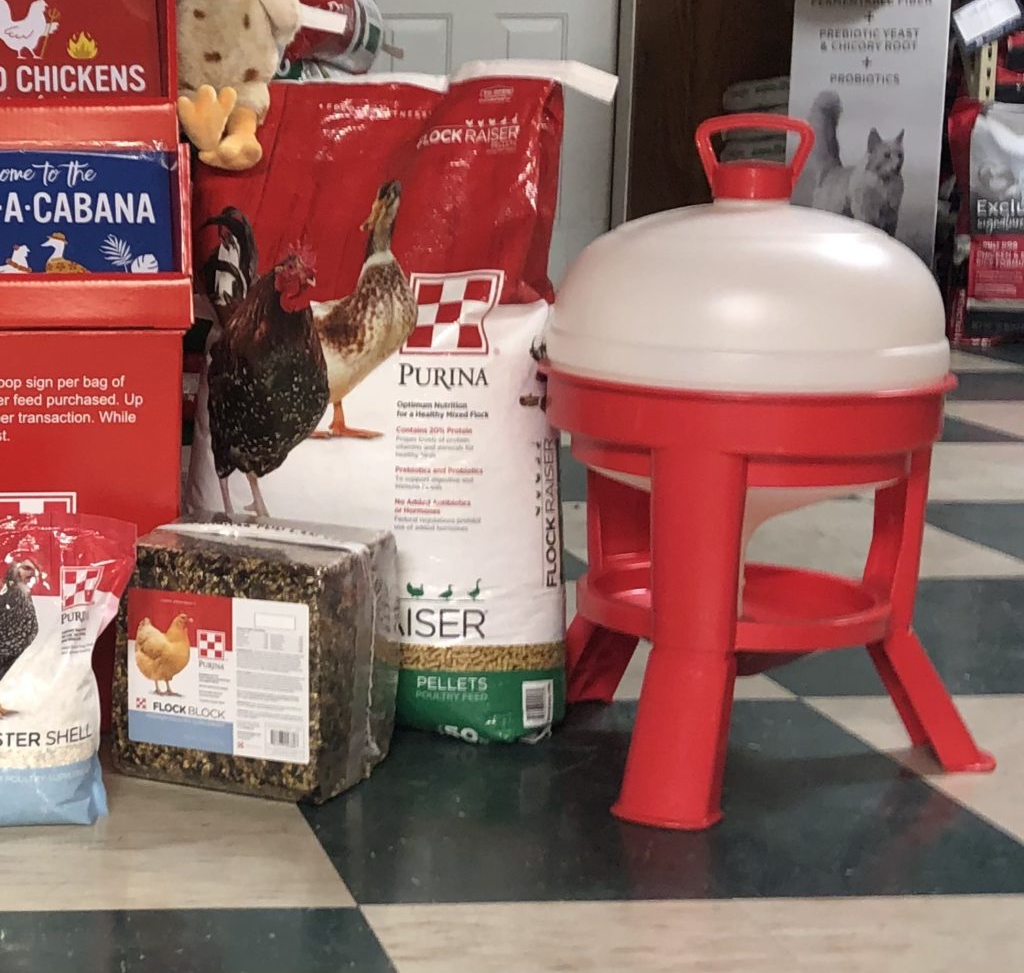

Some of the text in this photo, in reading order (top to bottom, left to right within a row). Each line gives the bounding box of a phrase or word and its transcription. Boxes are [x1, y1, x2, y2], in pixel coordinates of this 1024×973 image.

[819, 27, 919, 39] PREBIOTIC YEAST
[820, 41, 917, 51] & CHICORY ROOT
[17, 65, 145, 93] CHICKENS
[830, 73, 900, 85] PROBIOTICS
[466, 125, 520, 143] RAISER
[31, 161, 59, 187] to
[58, 161, 97, 187] the
[26, 376, 53, 393] sign
[58, 379, 79, 392] per
[84, 376, 108, 392] bag
[112, 376, 125, 389] of
[398, 363, 489, 390] PURINA
[13, 394, 42, 406] feed
[47, 393, 120, 410] purchased.
[124, 393, 143, 409] Up
[397, 400, 467, 410] Optimum Nutrition
[18, 411, 95, 424] transaction.
[99, 411, 136, 424] While
[416, 411, 444, 419] Healthy
[544, 439, 557, 587] FLOCK RAISER
[198, 660, 224, 670] PURINA
[417, 676, 488, 691] PELLETS
[415, 690, 488, 702] POULTRY FEED
[153, 702, 225, 719] FLOCK BLOCK
[46, 722, 92, 746] SHELL
